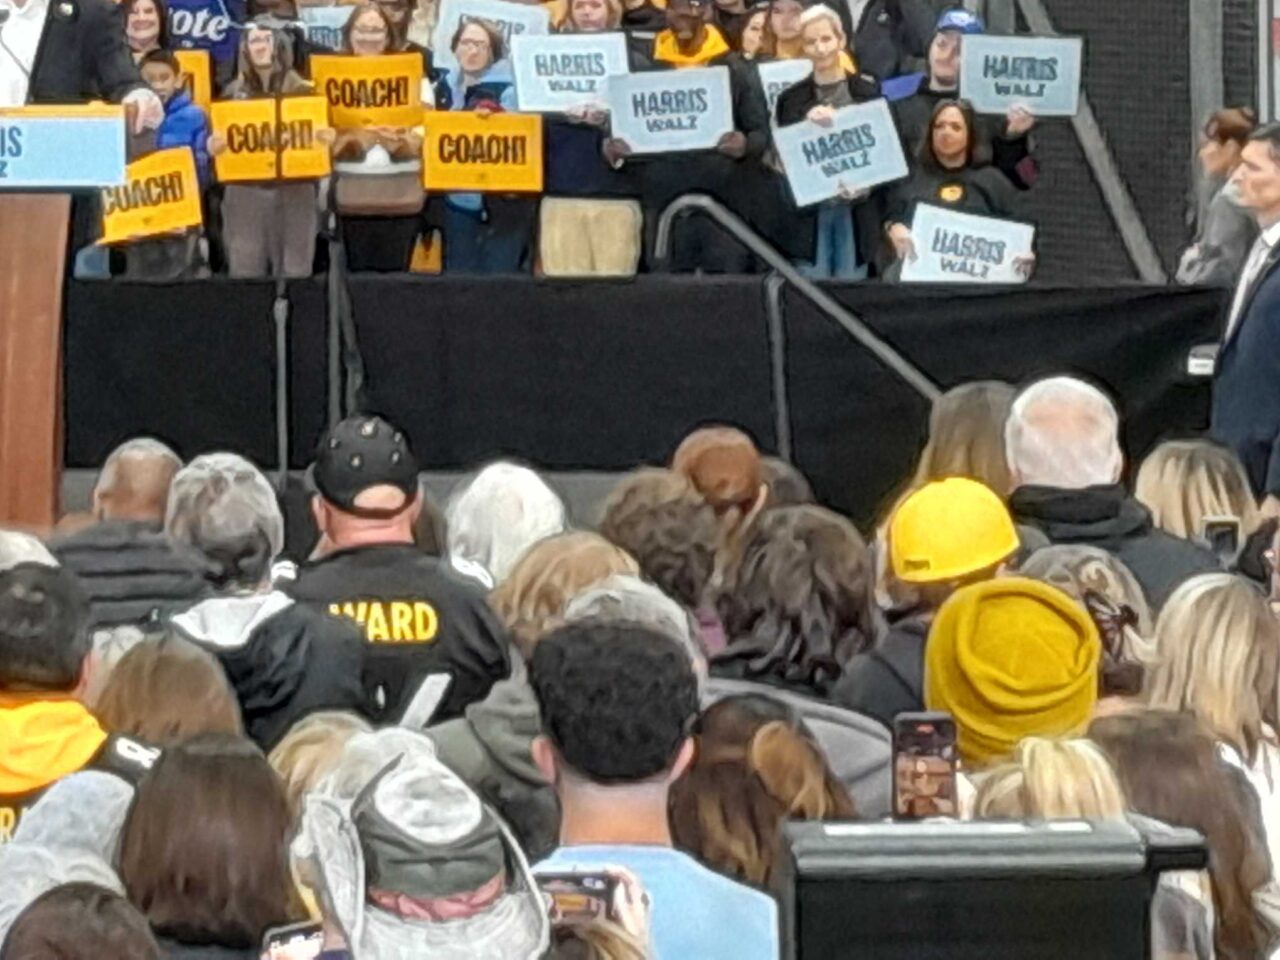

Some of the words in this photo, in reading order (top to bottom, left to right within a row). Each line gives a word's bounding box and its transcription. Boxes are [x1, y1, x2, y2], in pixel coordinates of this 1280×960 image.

[168, 5, 229, 41] ote
[535, 52, 606, 77] HARRIS
[983, 54, 1059, 82] HARRIS
[326, 75, 409, 108] COACH!
[548, 78, 596, 93] WALZ
[993, 81, 1046, 98] WALZ
[631, 87, 708, 118] HARRIS
[227, 119, 313, 154] COACH!
[646, 114, 698, 133] WALZ
[439, 133, 526, 165] COACH!
[801, 123, 876, 166] HARRIS
[819, 149, 872, 178] WALZ
[103, 171, 185, 216] COACH!
[939, 257, 989, 278] WALZ
